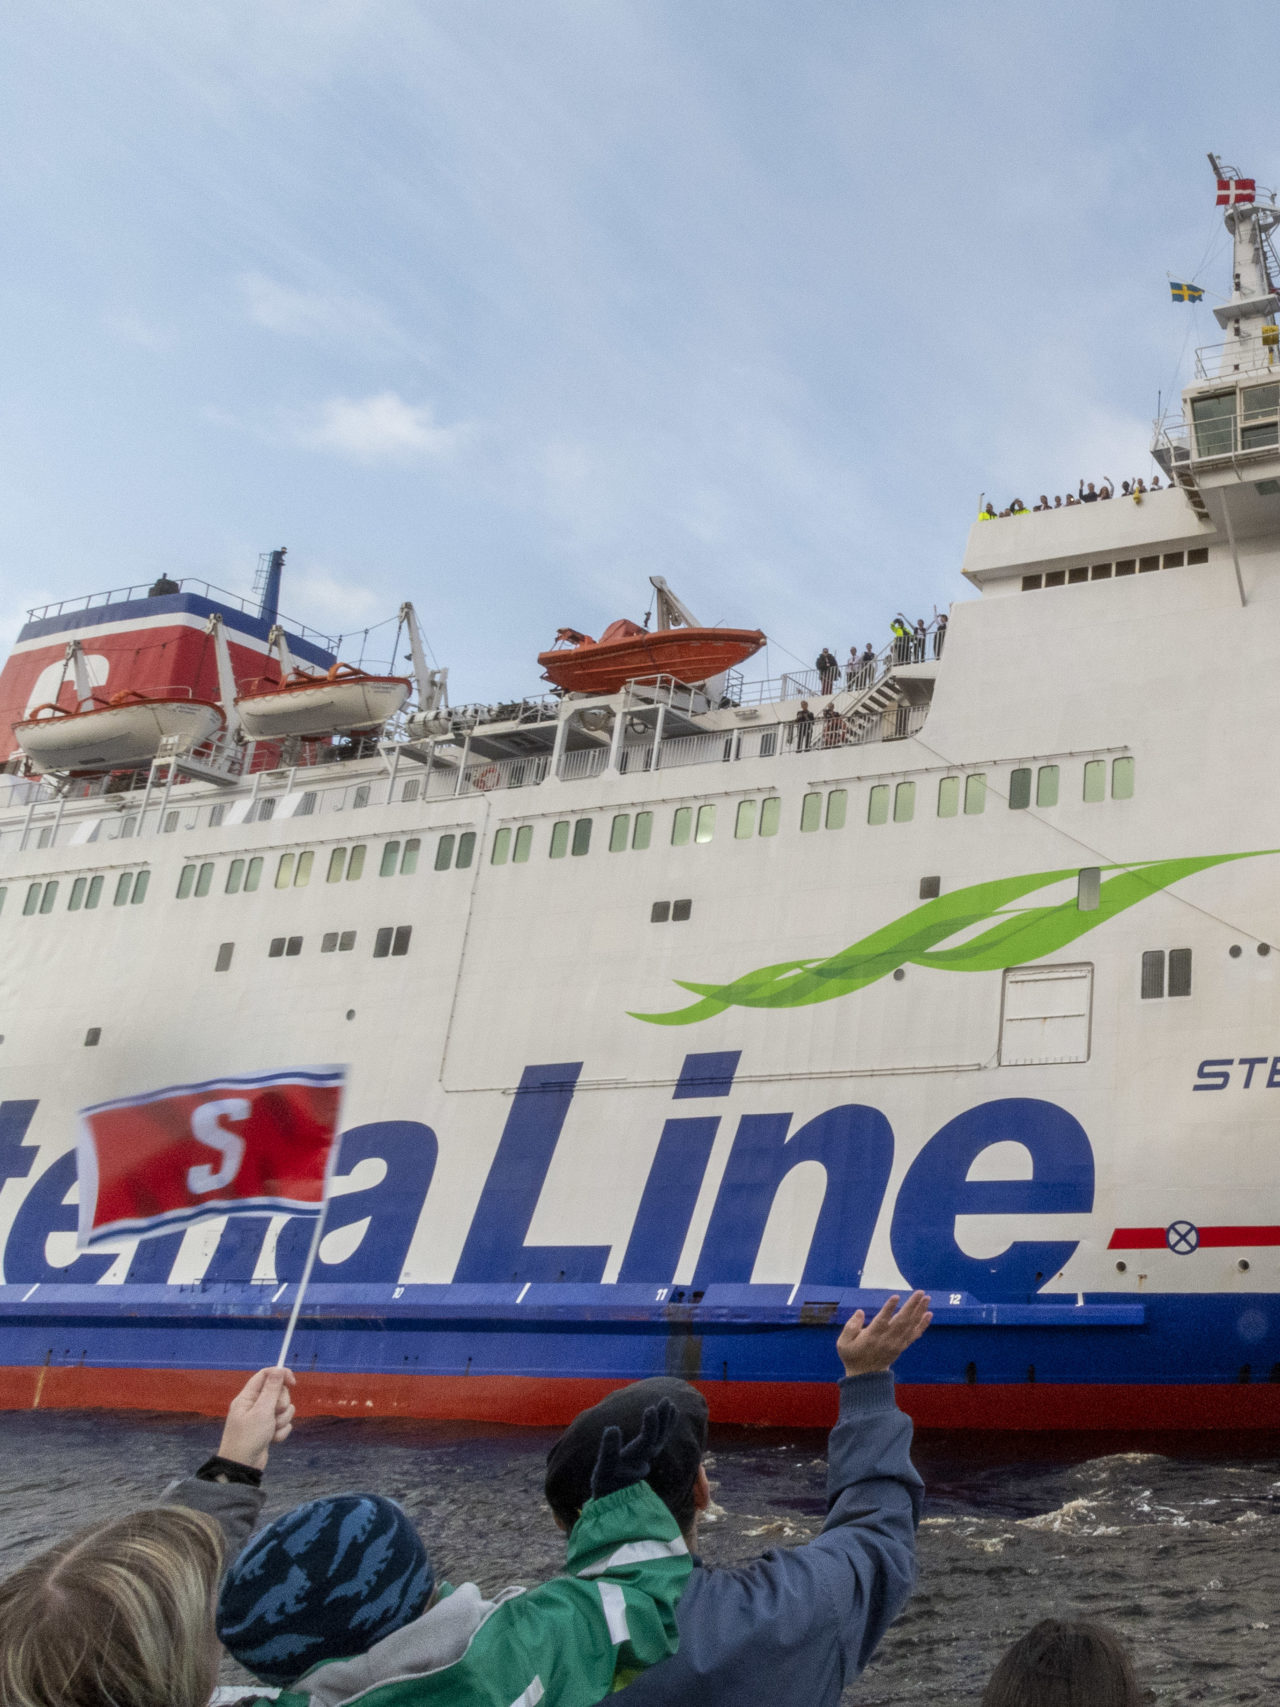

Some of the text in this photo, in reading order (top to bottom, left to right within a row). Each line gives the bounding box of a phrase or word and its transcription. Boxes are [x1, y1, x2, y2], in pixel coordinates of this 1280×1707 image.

[186, 1098, 252, 1195] S
[450, 1050, 1096, 1294] Line
[655, 1288, 669, 1301] 11
[949, 1293, 962, 1305] 12
